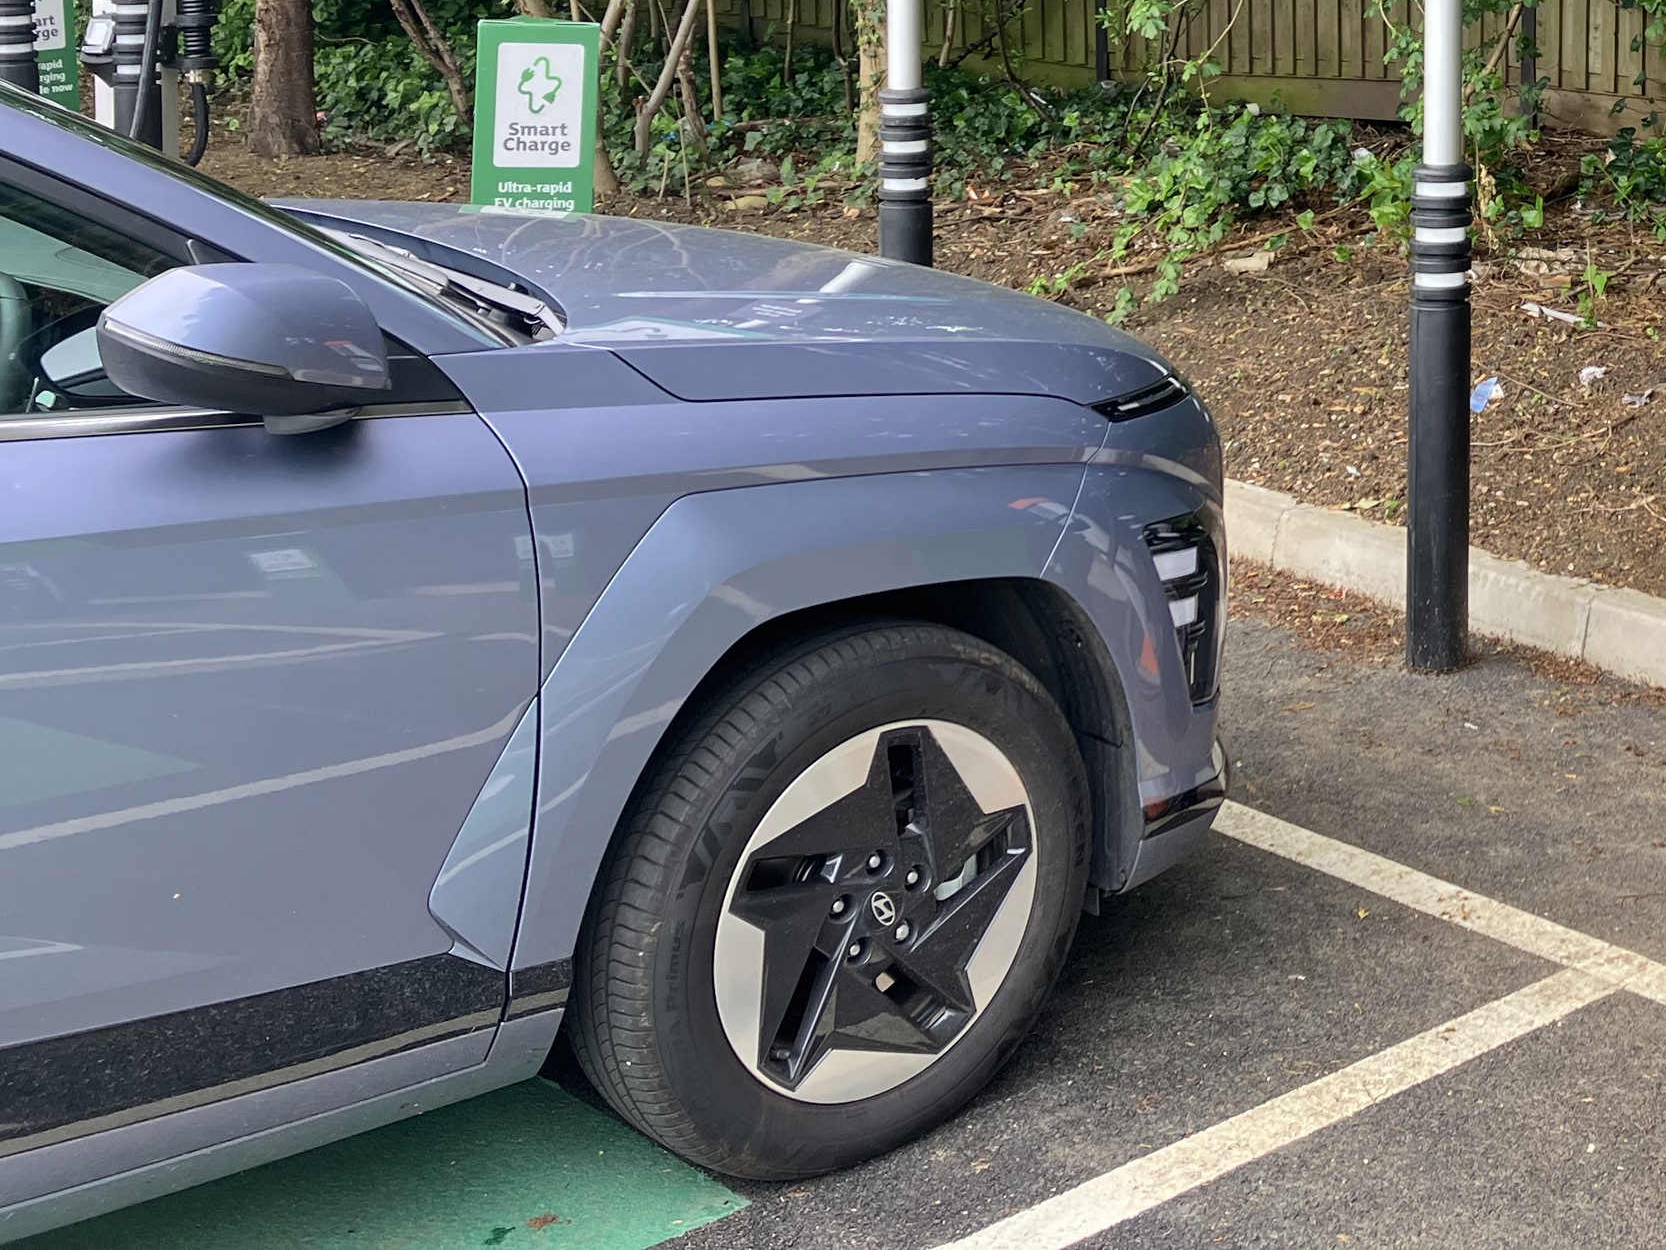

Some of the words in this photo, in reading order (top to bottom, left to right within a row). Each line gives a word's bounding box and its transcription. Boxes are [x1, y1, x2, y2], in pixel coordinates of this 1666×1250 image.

[35, 15, 55, 26] art
[52, 84, 73, 93] now
[509, 123, 567, 136] Smart
[503, 138, 571, 155] Charge
[499, 182, 572, 195] Ultra-rapid
[514, 197, 574, 211] charging
